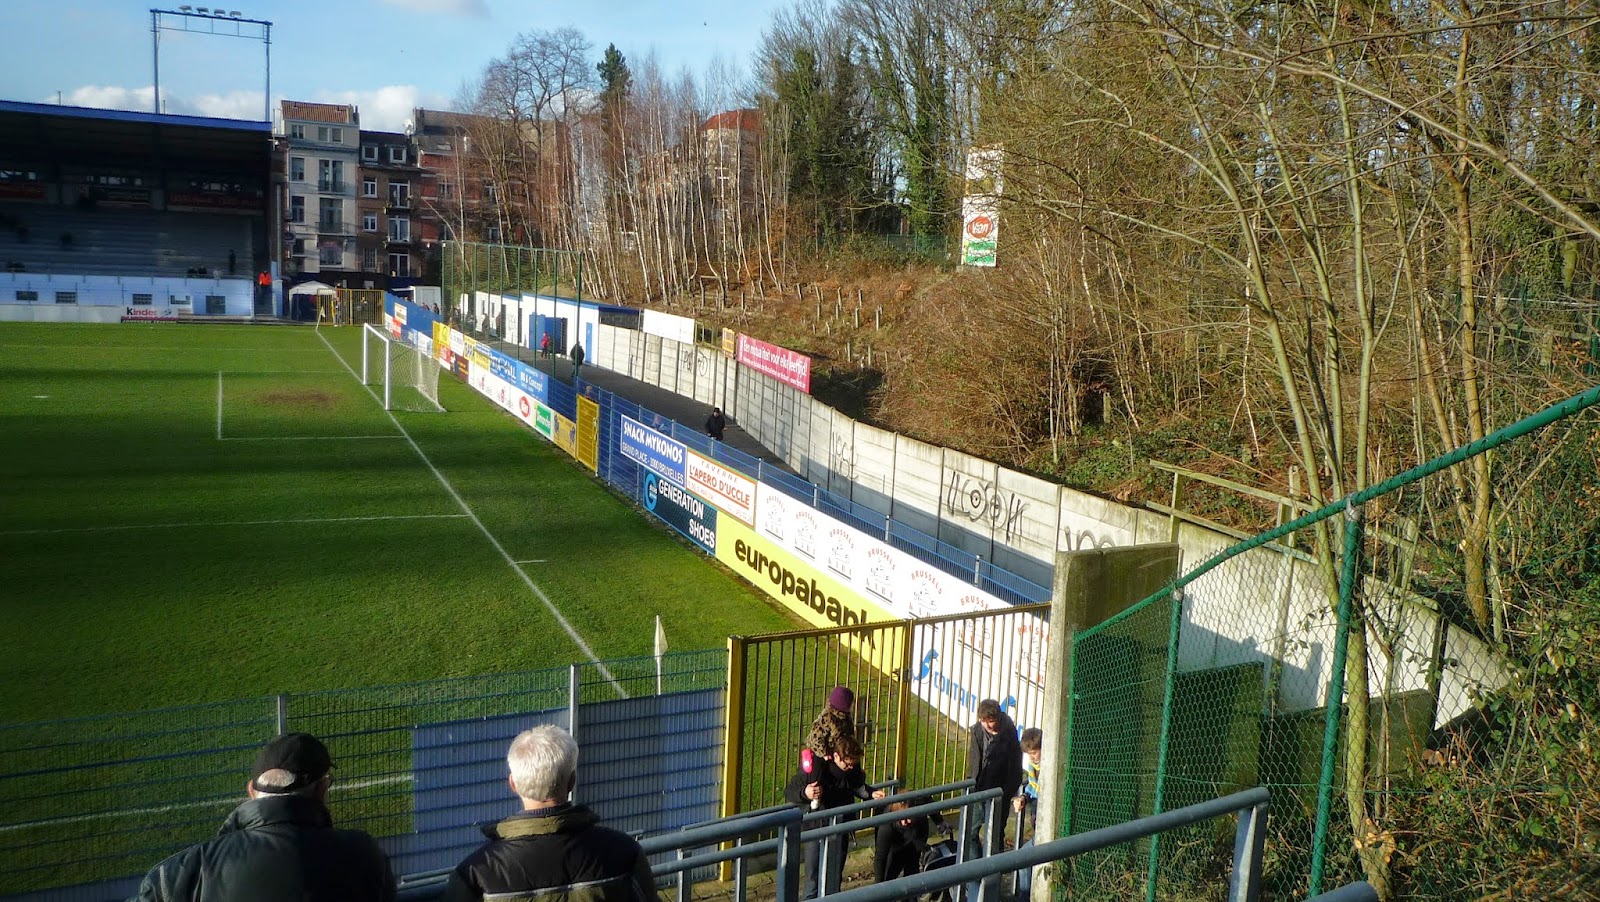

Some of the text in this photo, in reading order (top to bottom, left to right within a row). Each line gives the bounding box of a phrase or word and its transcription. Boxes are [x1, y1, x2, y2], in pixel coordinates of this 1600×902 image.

[623, 421, 683, 464] SNACK MYKONOS
[635, 449, 648, 464] PLACE
[659, 462, 684, 485] BRUXELLES
[701, 460, 739, 483] TAVERNE
[658, 479, 704, 520] GENERATION
[719, 479, 750, 506] D'UCCLE
[689, 518, 715, 549] SHOES
[867, 547, 896, 571] BRUSSELS
[734, 538, 876, 650] europabank
[911, 570, 943, 595] BRUSSELS
